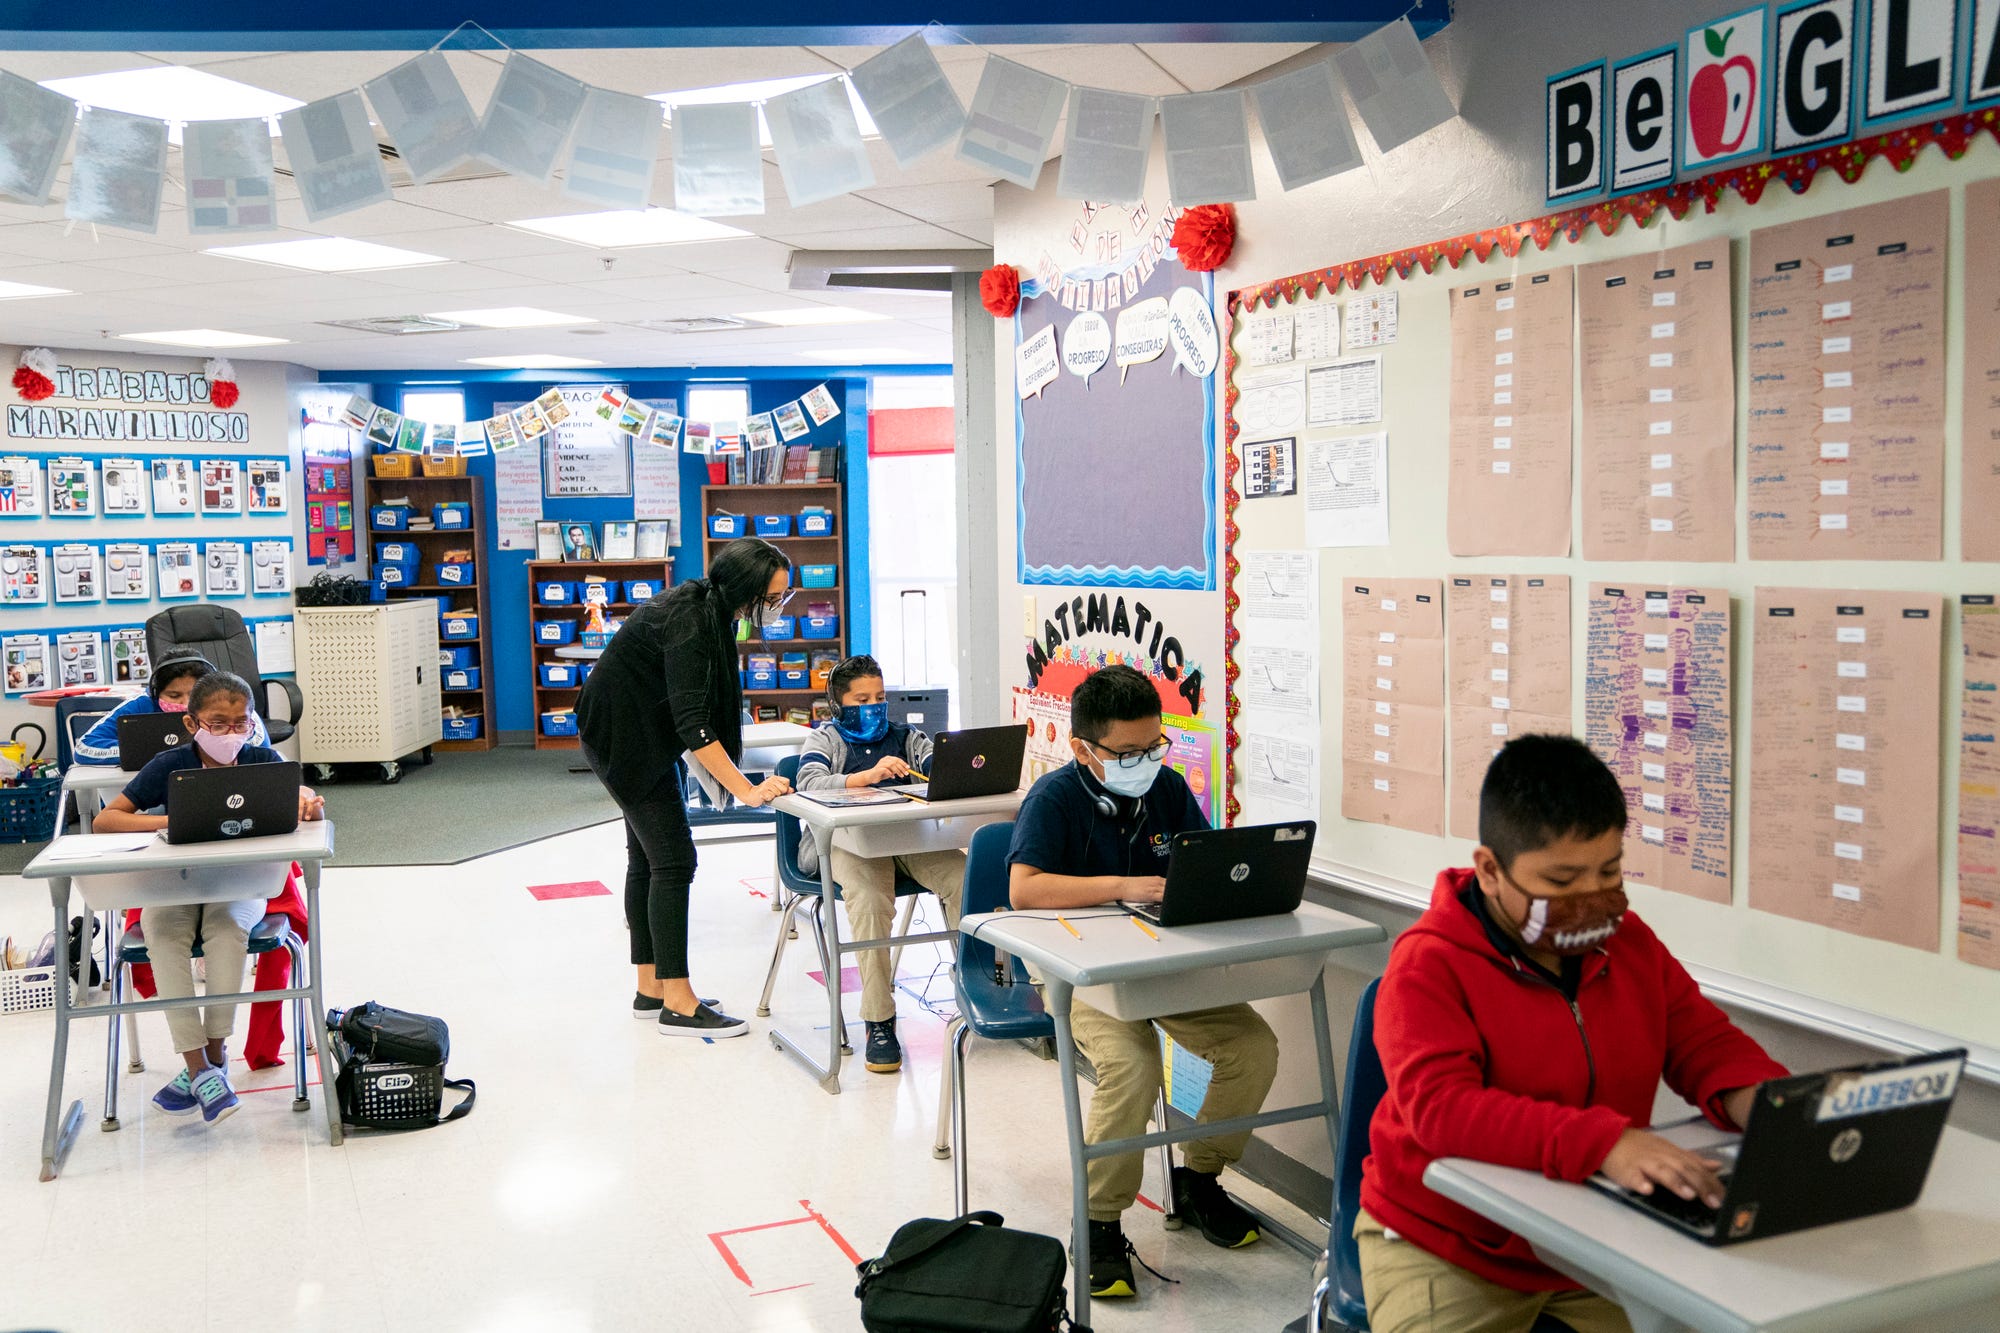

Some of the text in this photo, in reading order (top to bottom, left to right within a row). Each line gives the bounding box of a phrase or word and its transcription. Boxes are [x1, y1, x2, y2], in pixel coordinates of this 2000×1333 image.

[1555, 80, 1664, 190] Be
[1098, 235, 1119, 261] DE
[1116, 337, 1163, 358] CONSEGUIRAS
[1170, 315, 1206, 374] PROGRESO
[1068, 350, 1104, 364] PROGRESO
[56, 368, 209, 401] TRABAJO
[11, 407, 245, 441] MARAVILLOSO
[378, 515, 395, 524] 500
[717, 523, 733, 531] 900
[634, 588, 651, 596] 700
[543, 629, 560, 638] 700
[1026, 592, 1201, 715] MATEMATICA
[1053, 700, 1072, 712] Fraction
[1180, 733, 1196, 744] Area
